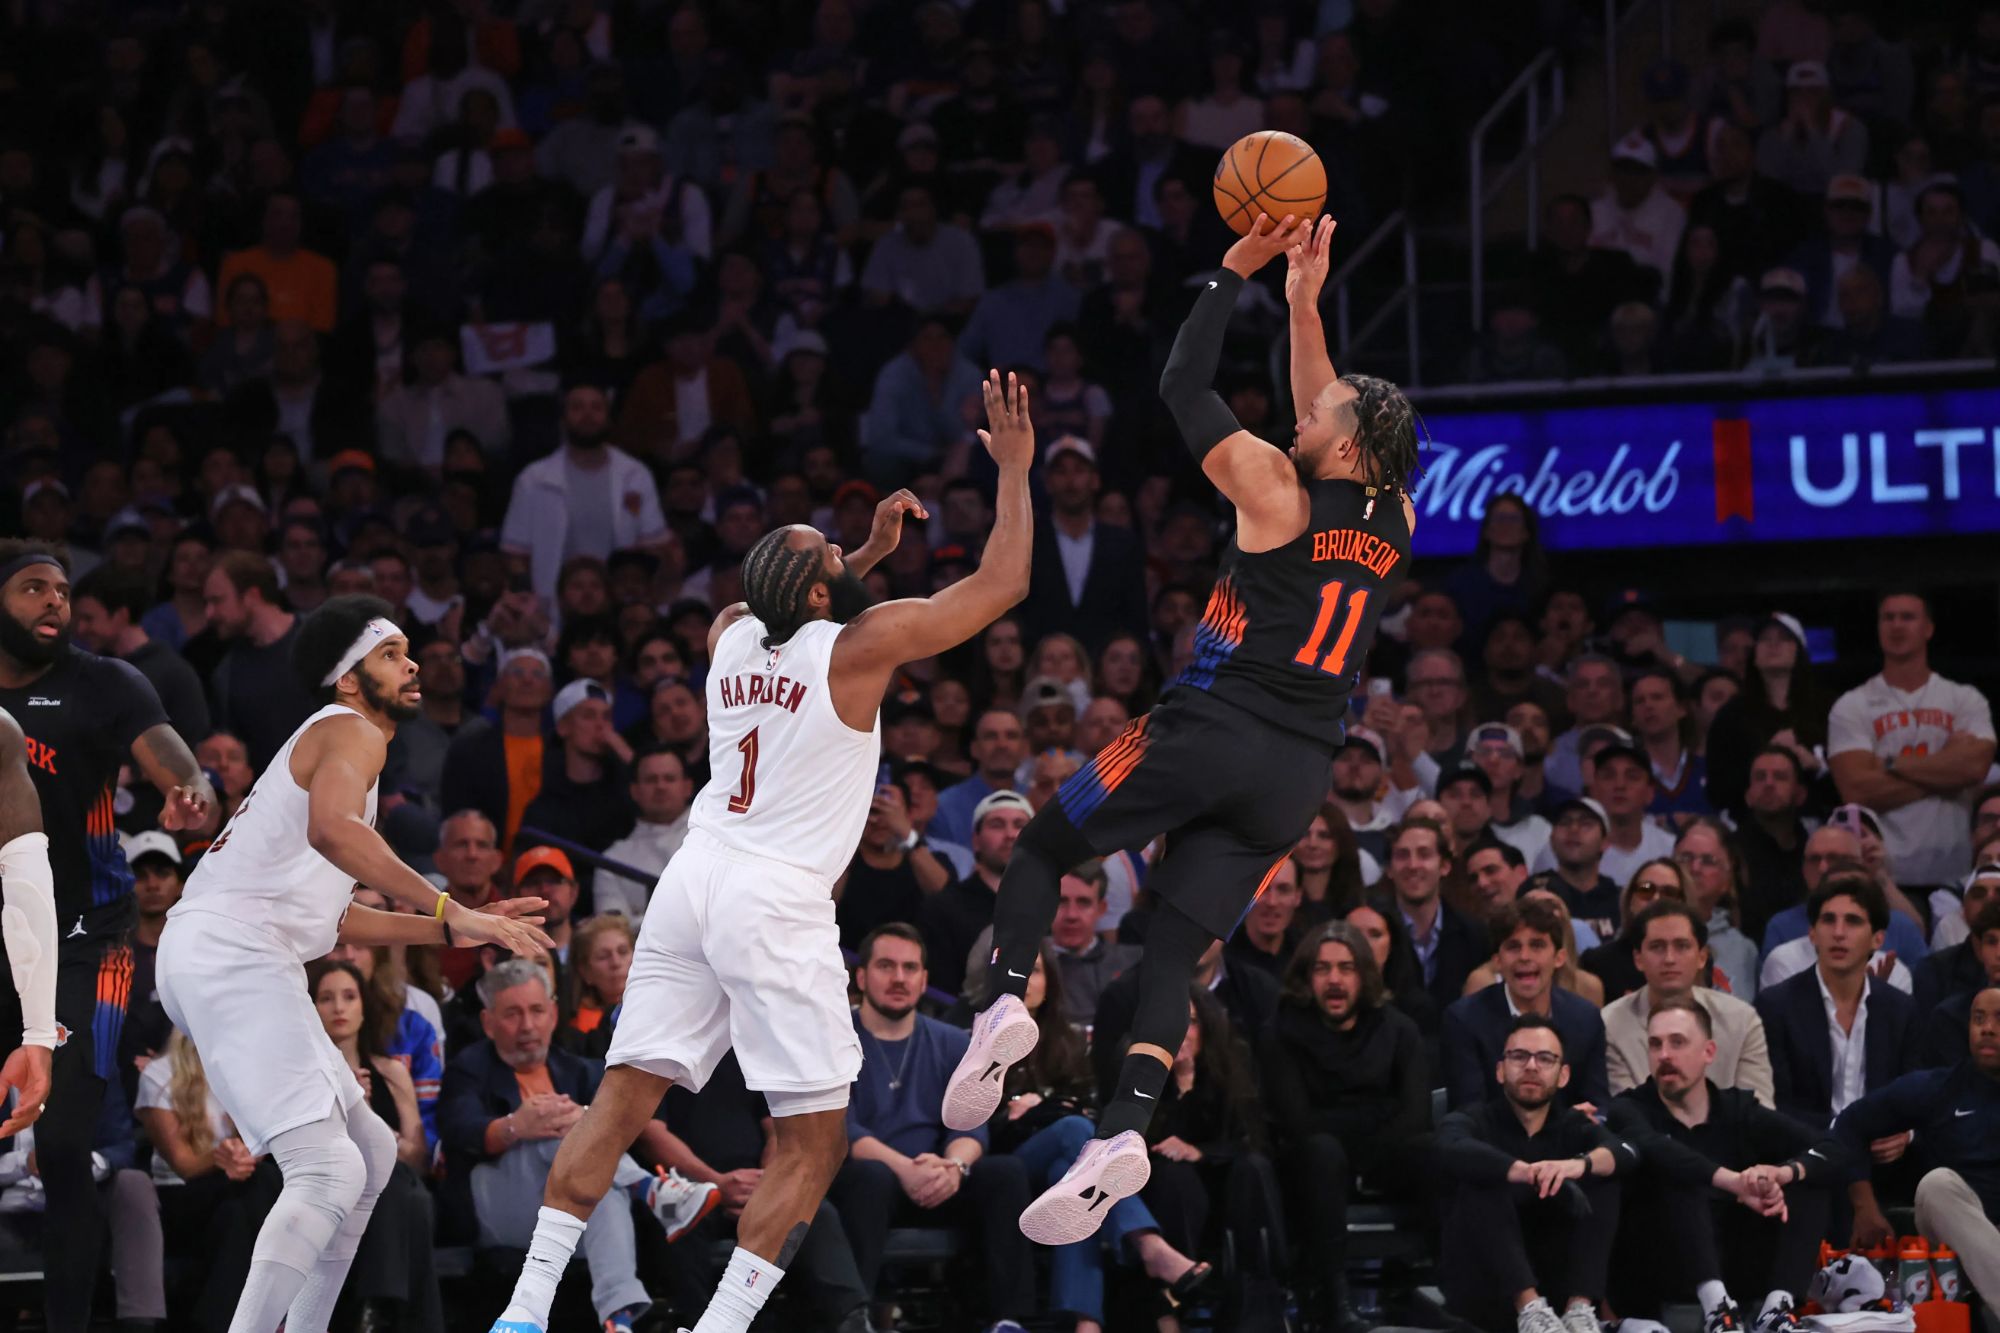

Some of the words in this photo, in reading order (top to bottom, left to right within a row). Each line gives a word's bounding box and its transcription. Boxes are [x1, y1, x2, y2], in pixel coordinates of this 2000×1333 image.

[1789, 426, 2000, 508] ULT
[1312, 529, 1400, 580] BRUNSON
[1293, 578, 1373, 677] 11
[720, 674, 808, 714] HARDEN
[25, 735, 57, 775] RK
[727, 724, 760, 815] 1
